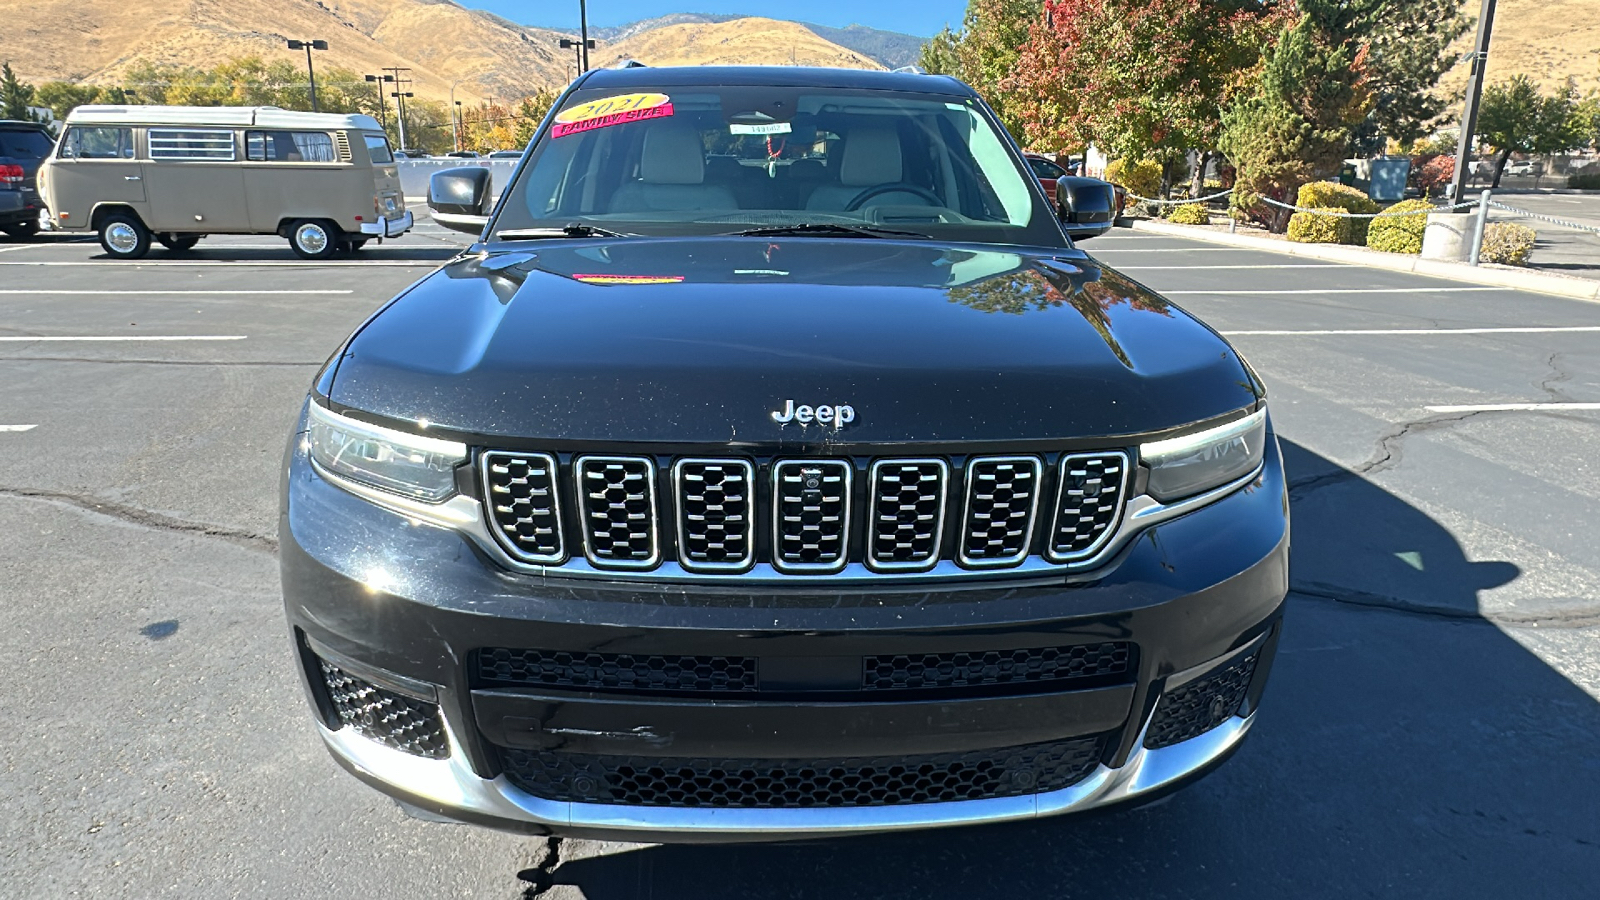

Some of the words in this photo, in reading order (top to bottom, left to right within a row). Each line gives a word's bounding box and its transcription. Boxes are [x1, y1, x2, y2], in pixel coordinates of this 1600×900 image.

[561, 113, 624, 134] FAMILY
[626, 106, 664, 119] SIZE
[577, 96, 647, 119] 2021
[771, 399, 855, 429] Jeep
